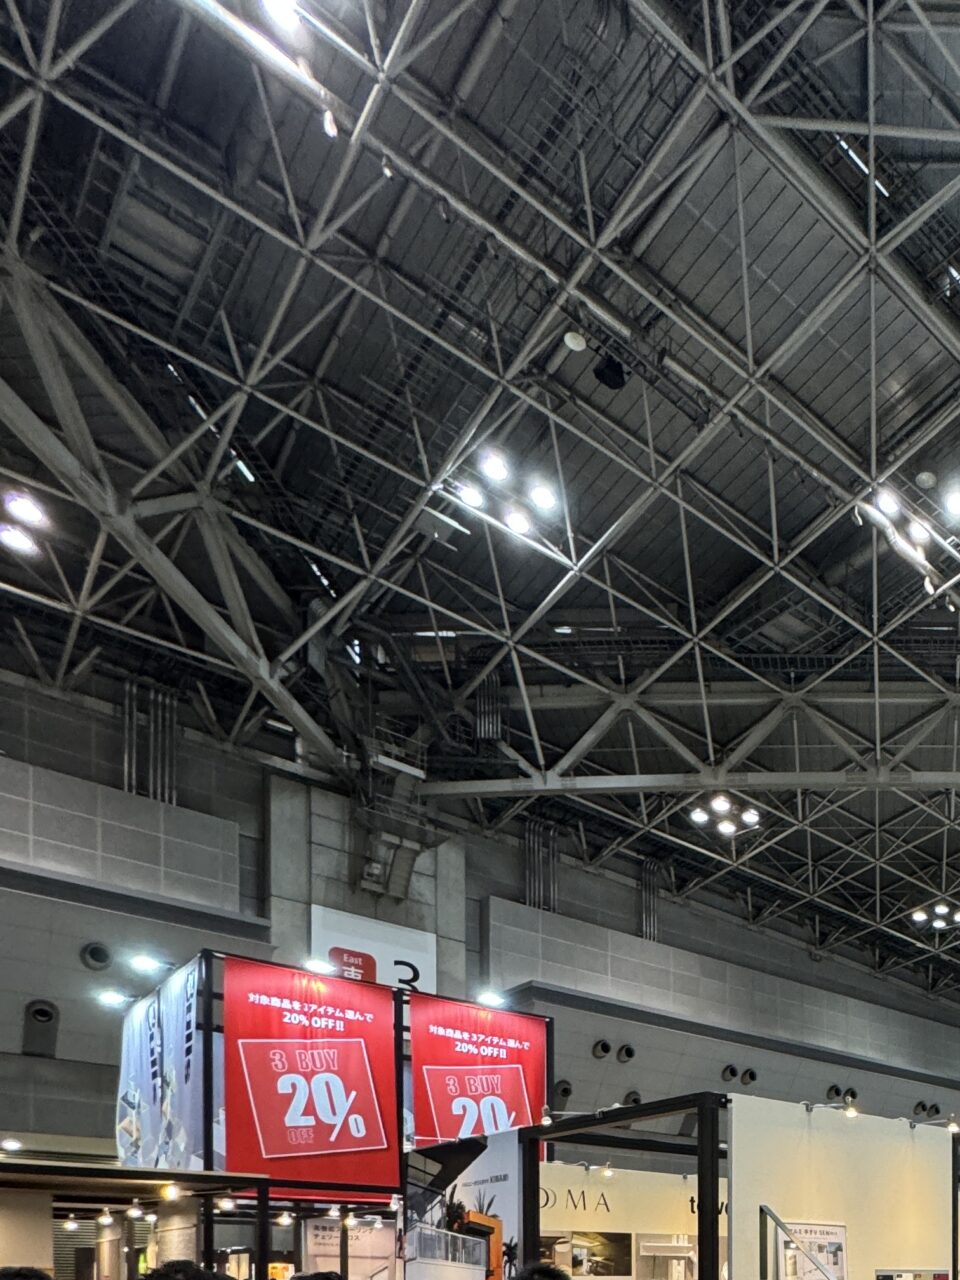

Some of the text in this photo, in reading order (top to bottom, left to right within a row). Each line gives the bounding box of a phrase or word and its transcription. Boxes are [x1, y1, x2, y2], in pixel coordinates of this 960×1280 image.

[343, 953, 363, 965] East
[394, 960, 420, 992] 3
[282, 1011, 309, 1027] 20%
[455, 1041, 478, 1055] 20%
[270, 1049, 338, 1072] 3 BUY
[446, 1074, 501, 1096] 3 BUY
[277, 1073, 366, 1142] 20%
[452, 1095, 516, 1140] 20
[287, 1128, 314, 1144] OFF
